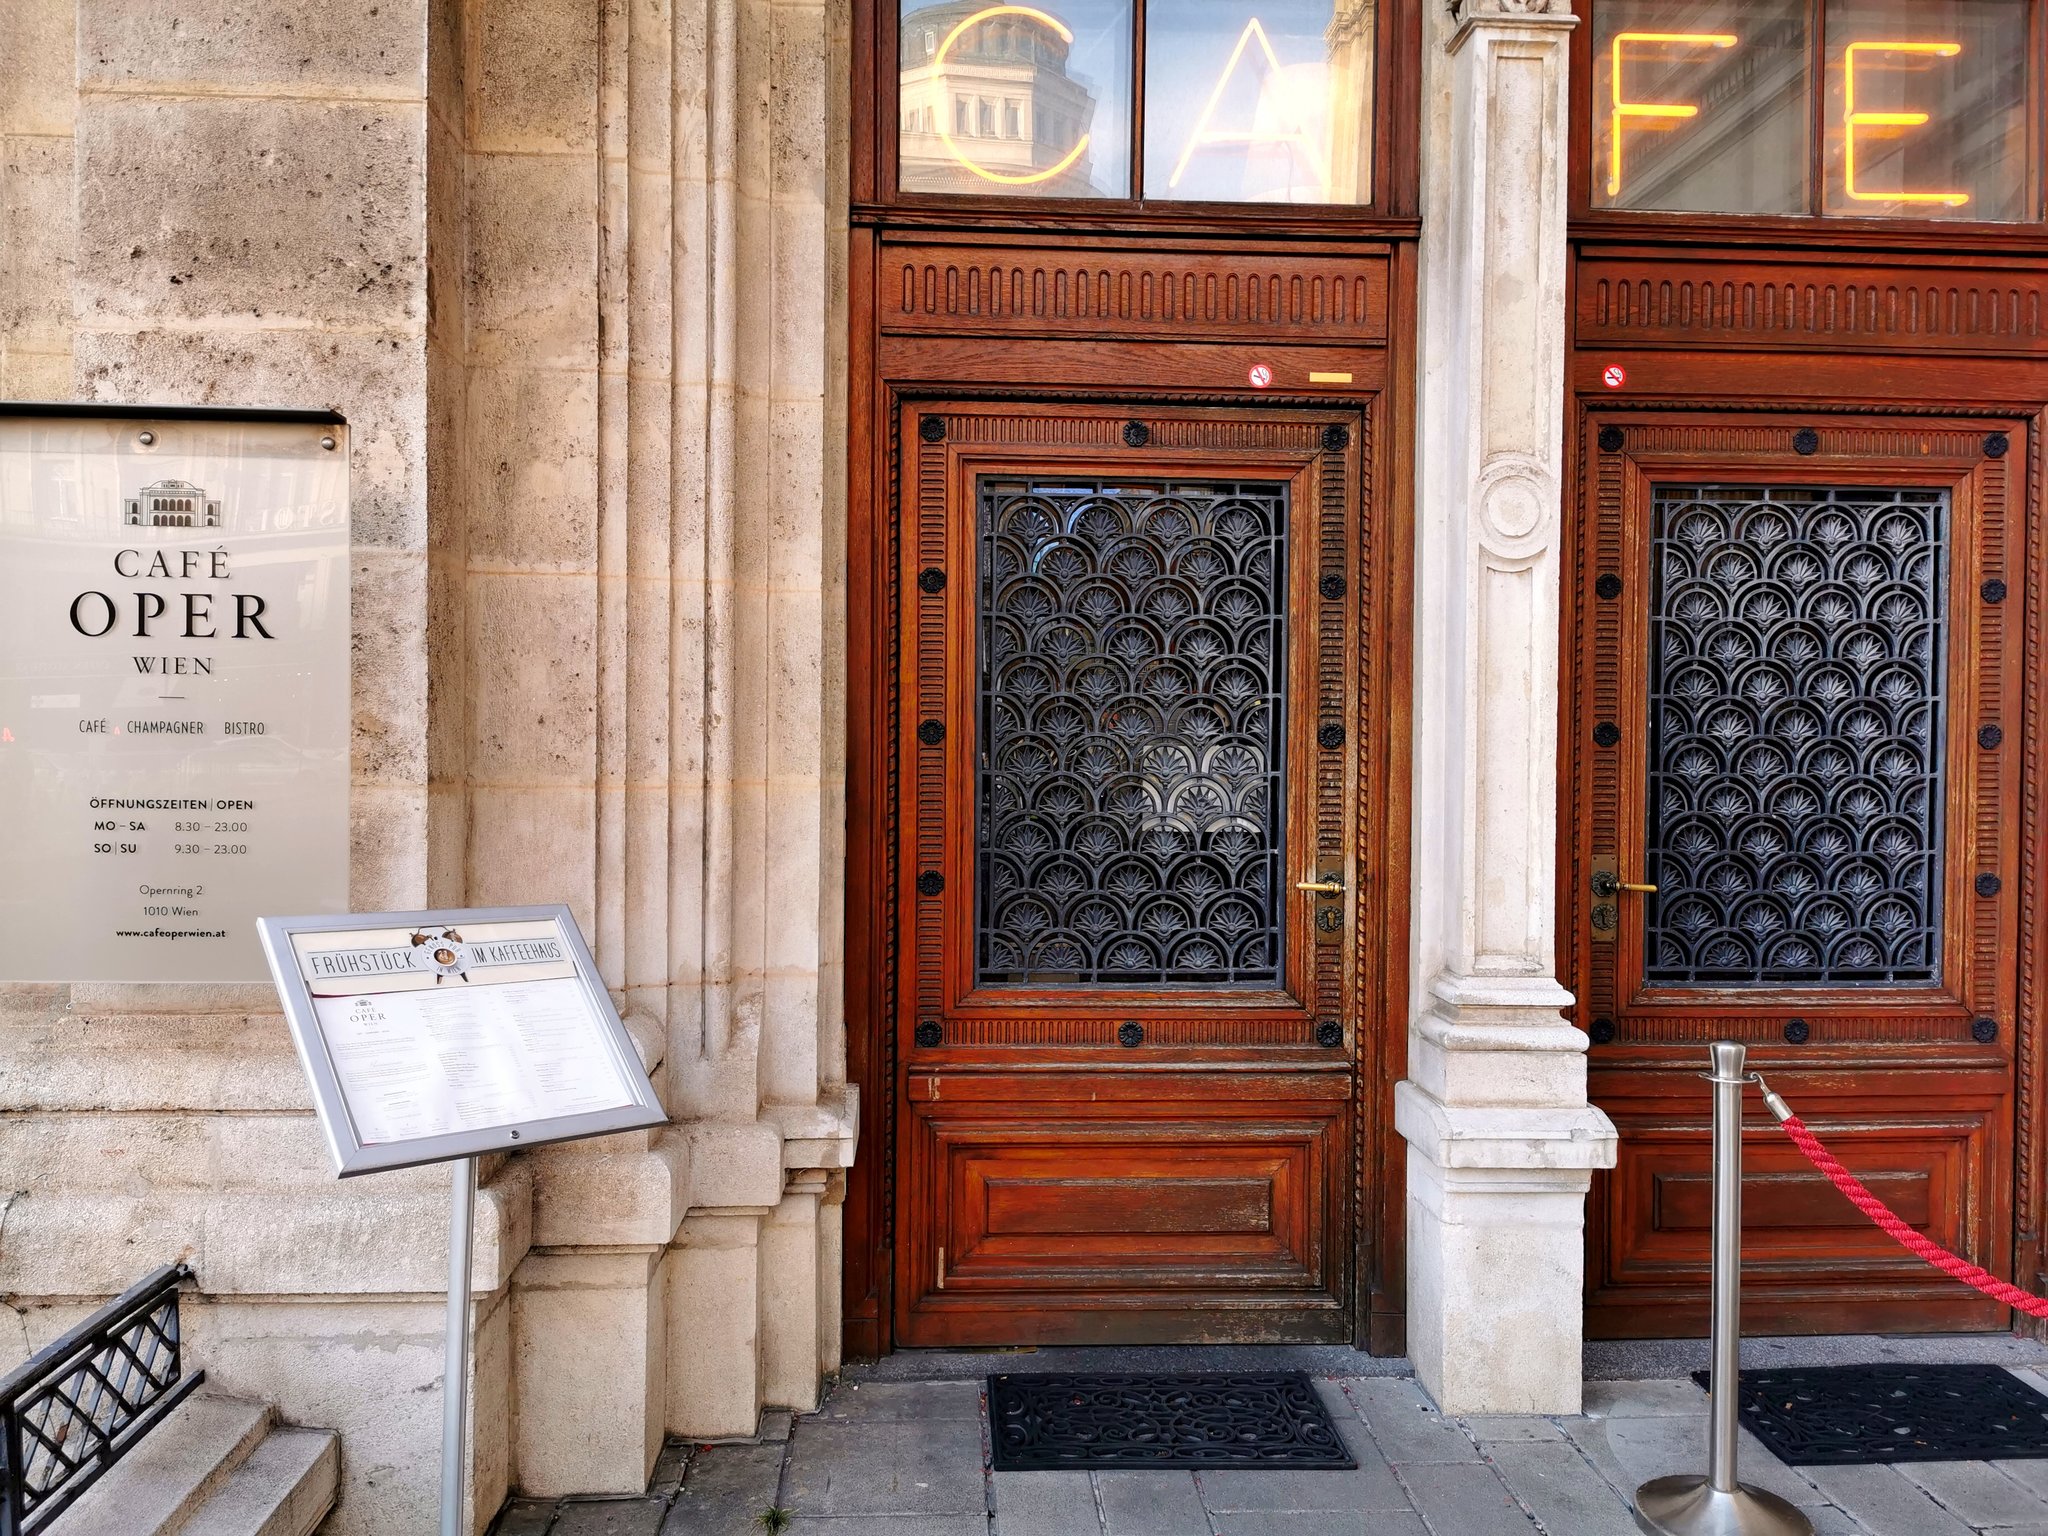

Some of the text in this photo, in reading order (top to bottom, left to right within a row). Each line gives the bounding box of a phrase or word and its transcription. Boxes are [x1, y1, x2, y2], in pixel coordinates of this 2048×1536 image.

[114, 545, 231, 579] CAFÉ
[69, 590, 275, 639] OPER
[132, 656, 213, 675] WIEN
[78, 717, 265, 735] CAFÉ CHAMPAGNER BISTRO
[89, 796, 207, 810] ÖFFNUNGSZEITEN
[216, 800, 253, 810] OPEN
[94, 821, 116, 831] MO
[129, 821, 146, 831] SA
[174, 822, 201, 832] 8.30
[214, 822, 248, 832] 23.00
[94, 843, 112, 853] SO
[120, 844, 137, 853] SU
[174, 844, 200, 854] 9.30
[214, 844, 247, 854] 23.00
[139, 884, 203, 898] Opernring 2
[144, 906, 198, 916] 1010 Wien
[116, 927, 226, 940] www.cafeoperwien.at
[311, 941, 561, 975] FRÜHSTÜCK IM KAFFEEHAUS
[350, 1013, 387, 1022] OPER
